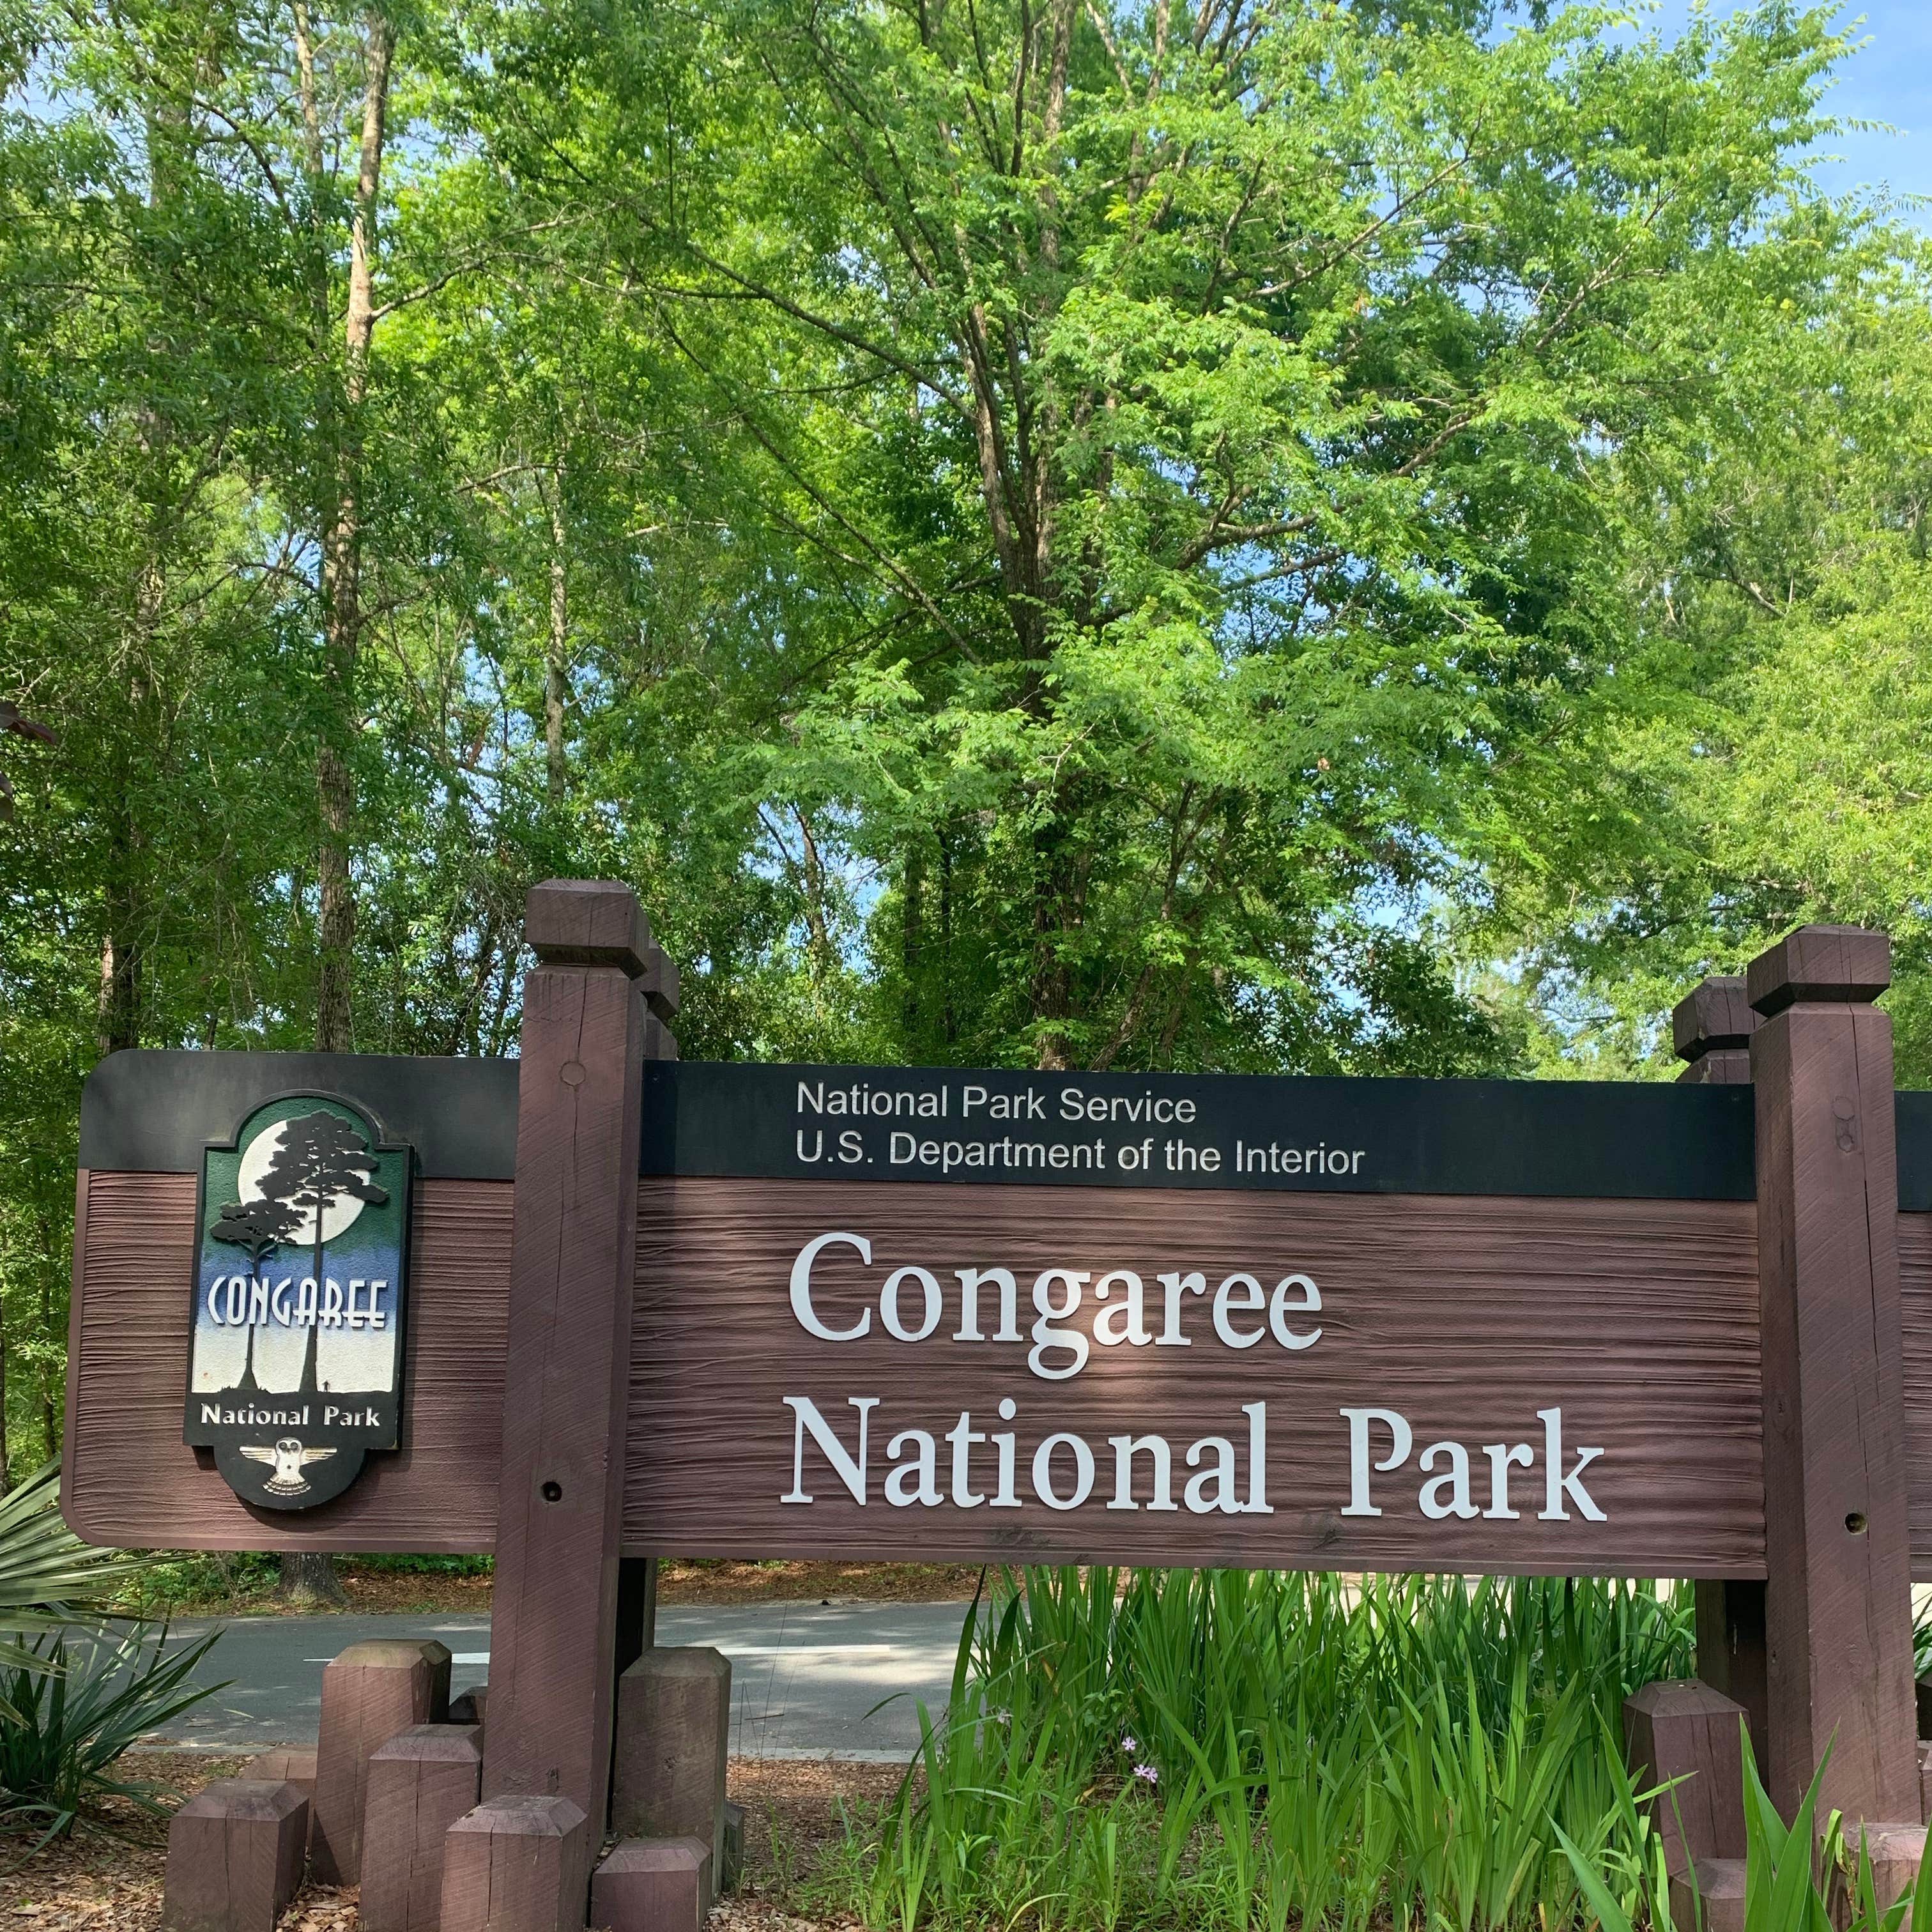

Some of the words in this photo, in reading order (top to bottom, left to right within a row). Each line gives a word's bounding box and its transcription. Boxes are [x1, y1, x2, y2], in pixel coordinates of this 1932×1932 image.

[797, 1082, 947, 1117] National
[963, 1085, 1046, 1119] Park
[1059, 1088, 1196, 1123] Service
[797, 1130, 873, 1163] U.S.
[889, 1132, 1105, 1173] Department
[1118, 1137, 1154, 1170] of
[1165, 1140, 1221, 1172] the
[1236, 1141, 1365, 1175] Interior
[207, 1276, 388, 1328] CONGAREE
[789, 1232, 1323, 1380] Congaree
[200, 1402, 309, 1426] National
[323, 1406, 380, 1427] Park
[779, 1397, 1275, 1514] National
[1339, 1407, 1608, 1522] Park
